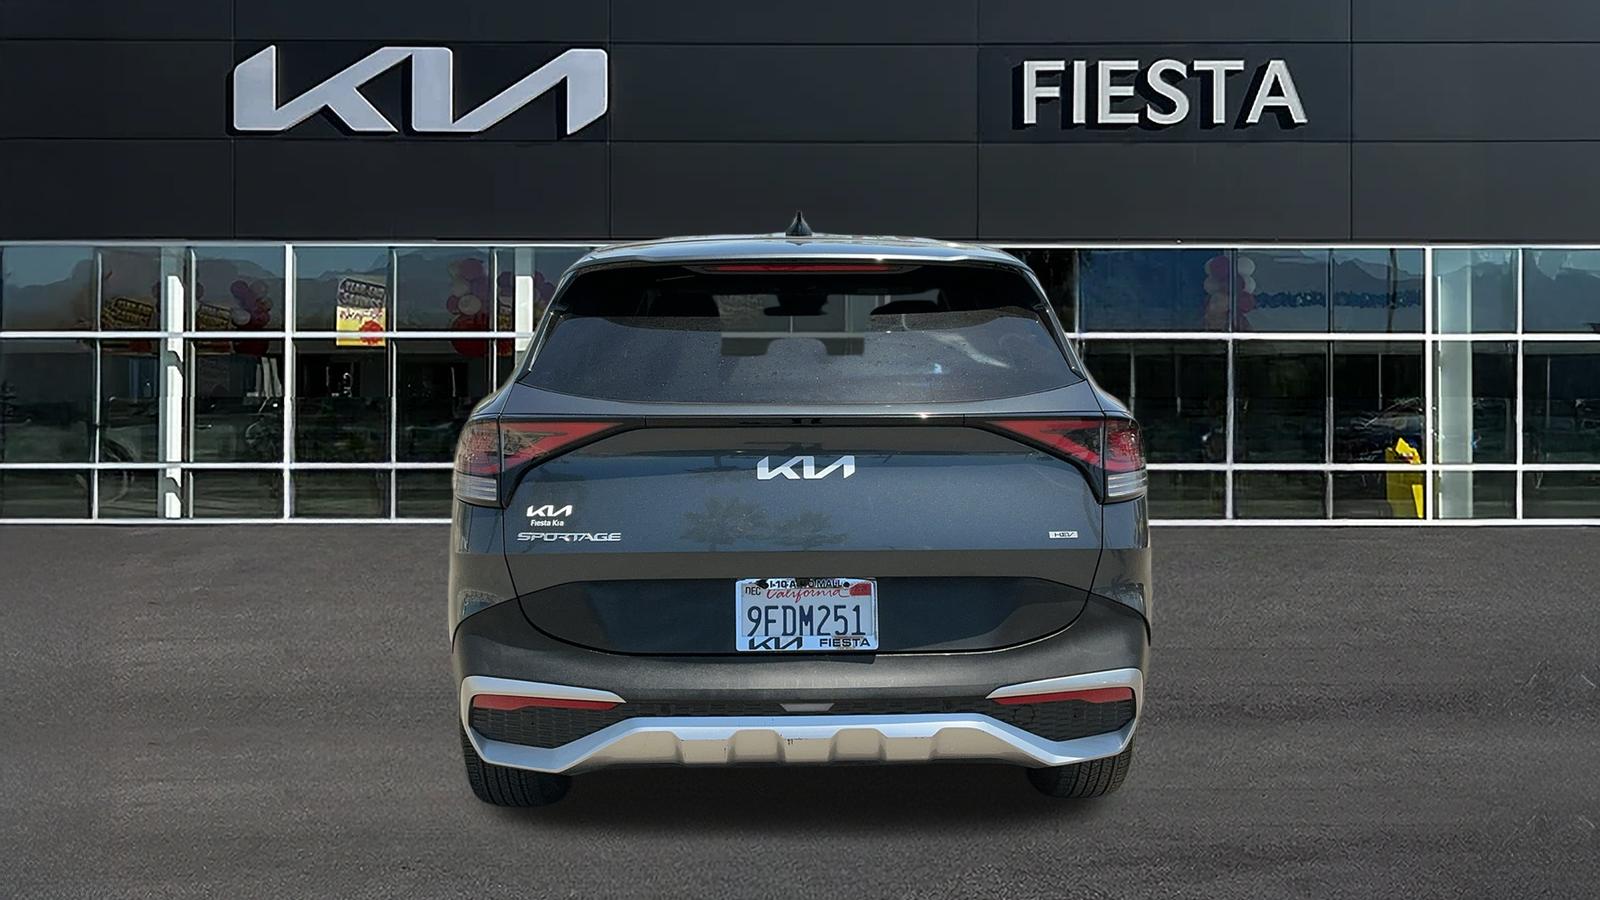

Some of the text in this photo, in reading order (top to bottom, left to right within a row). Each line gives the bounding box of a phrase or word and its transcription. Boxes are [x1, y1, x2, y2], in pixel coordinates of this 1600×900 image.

[233, 44, 608, 135] KIA
[1023, 59, 1308, 125] FIESTA
[757, 455, 855, 480] KIA
[526, 504, 573, 517] KIA
[530, 519, 564, 527] Fiesta Kia
[517, 532, 622, 542] SPORTAGE
[766, 588, 842, 603] California
[747, 604, 866, 637] 9FDM251
[748, 636, 803, 650] KIA
[819, 638, 871, 648] FIESTA
